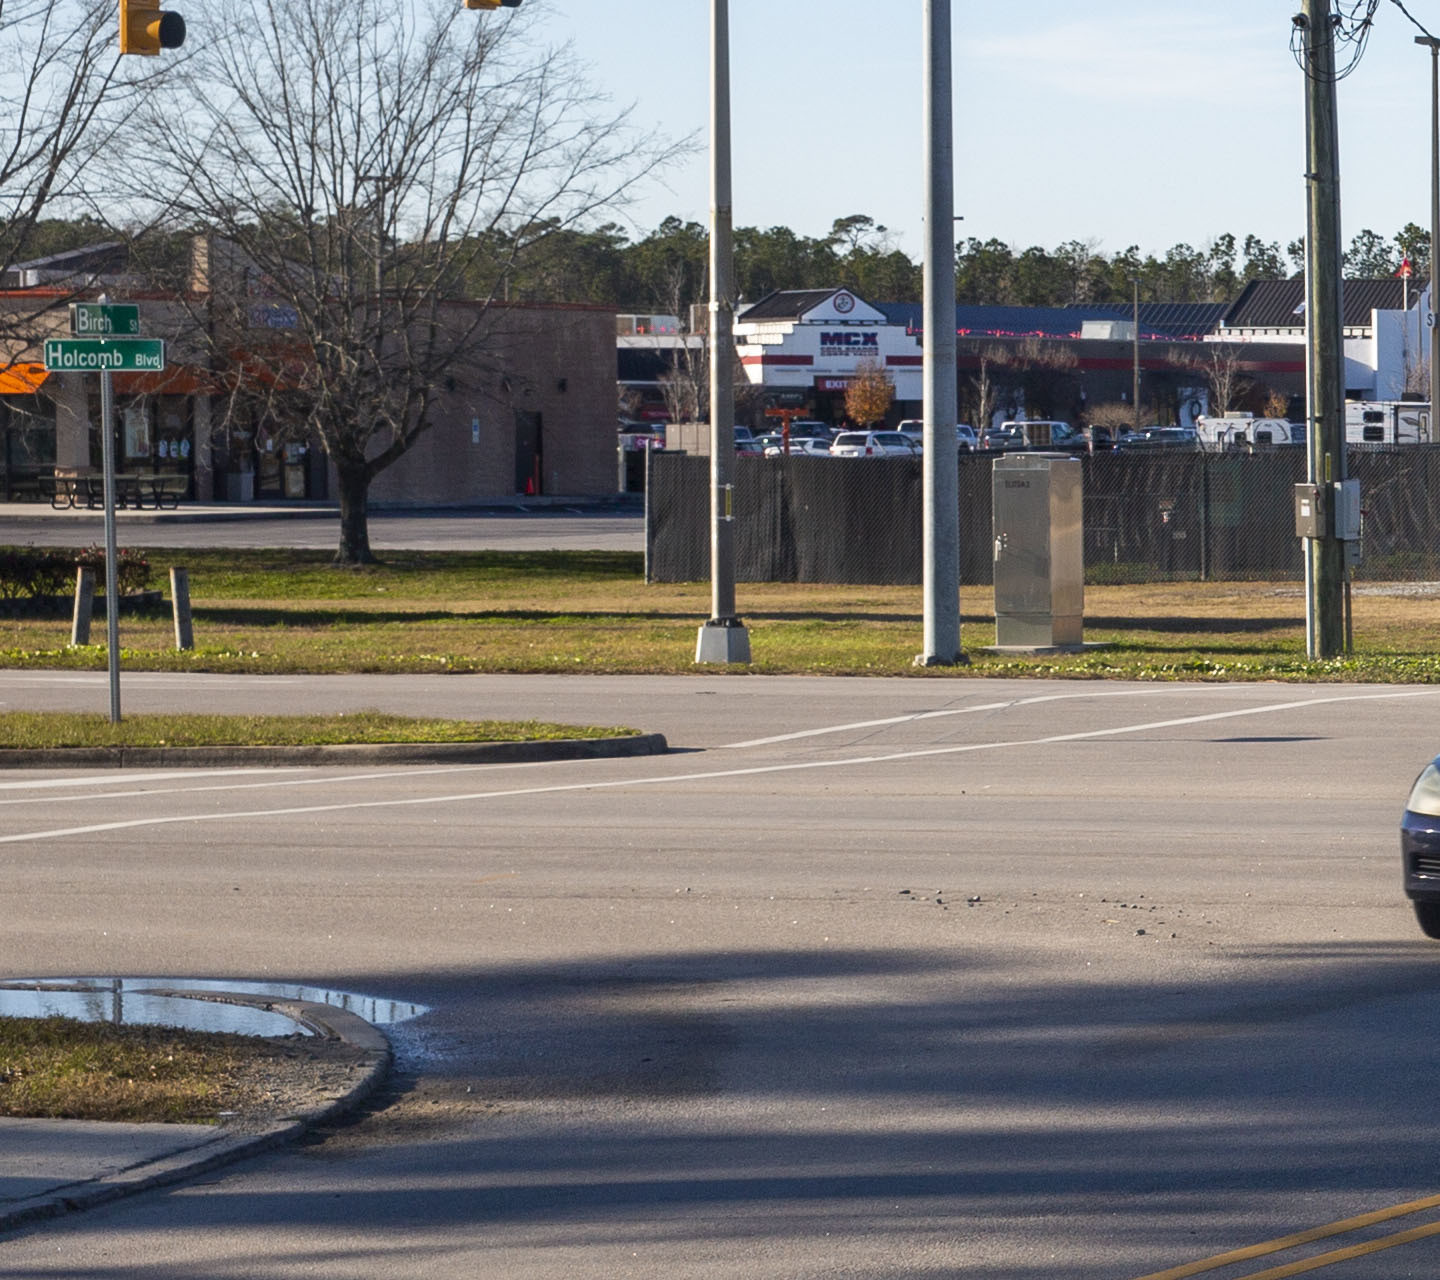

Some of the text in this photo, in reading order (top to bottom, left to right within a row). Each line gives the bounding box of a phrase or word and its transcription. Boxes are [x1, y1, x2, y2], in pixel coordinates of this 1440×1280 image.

[79, 308, 138, 332] Birch St
[820, 332, 879, 346] MCX
[48, 343, 160, 366] Holcomb Blvd
